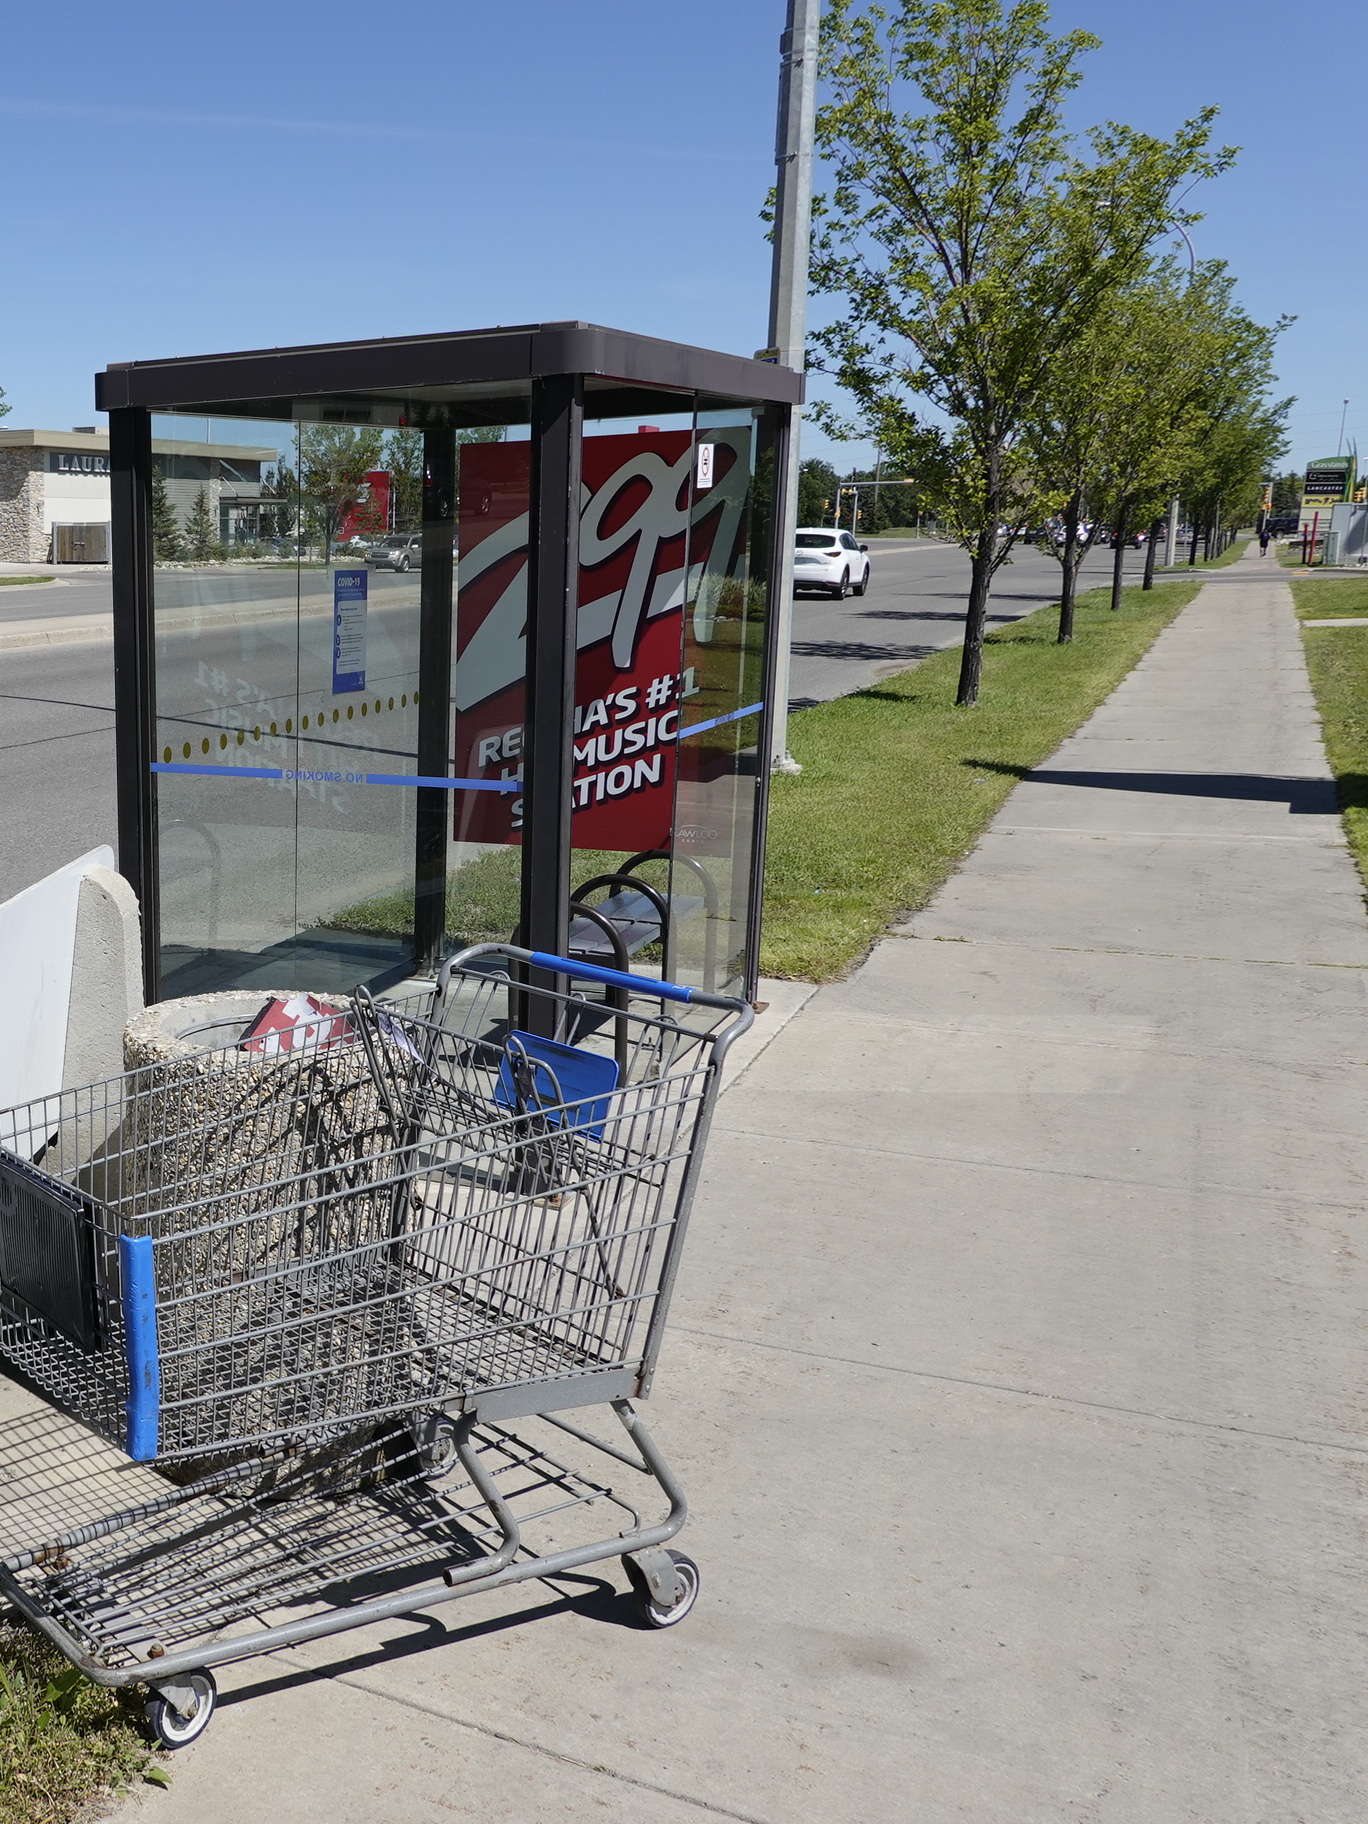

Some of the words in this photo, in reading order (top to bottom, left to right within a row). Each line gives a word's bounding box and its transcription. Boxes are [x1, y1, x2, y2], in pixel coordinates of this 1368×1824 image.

[1311, 461, 1349, 469] Grasslands
[337, 577, 360, 587] COVID-19
[645, 666, 701, 709] #1
[573, 709, 679, 768] MUSIC
[511, 753, 663, 829] STION
